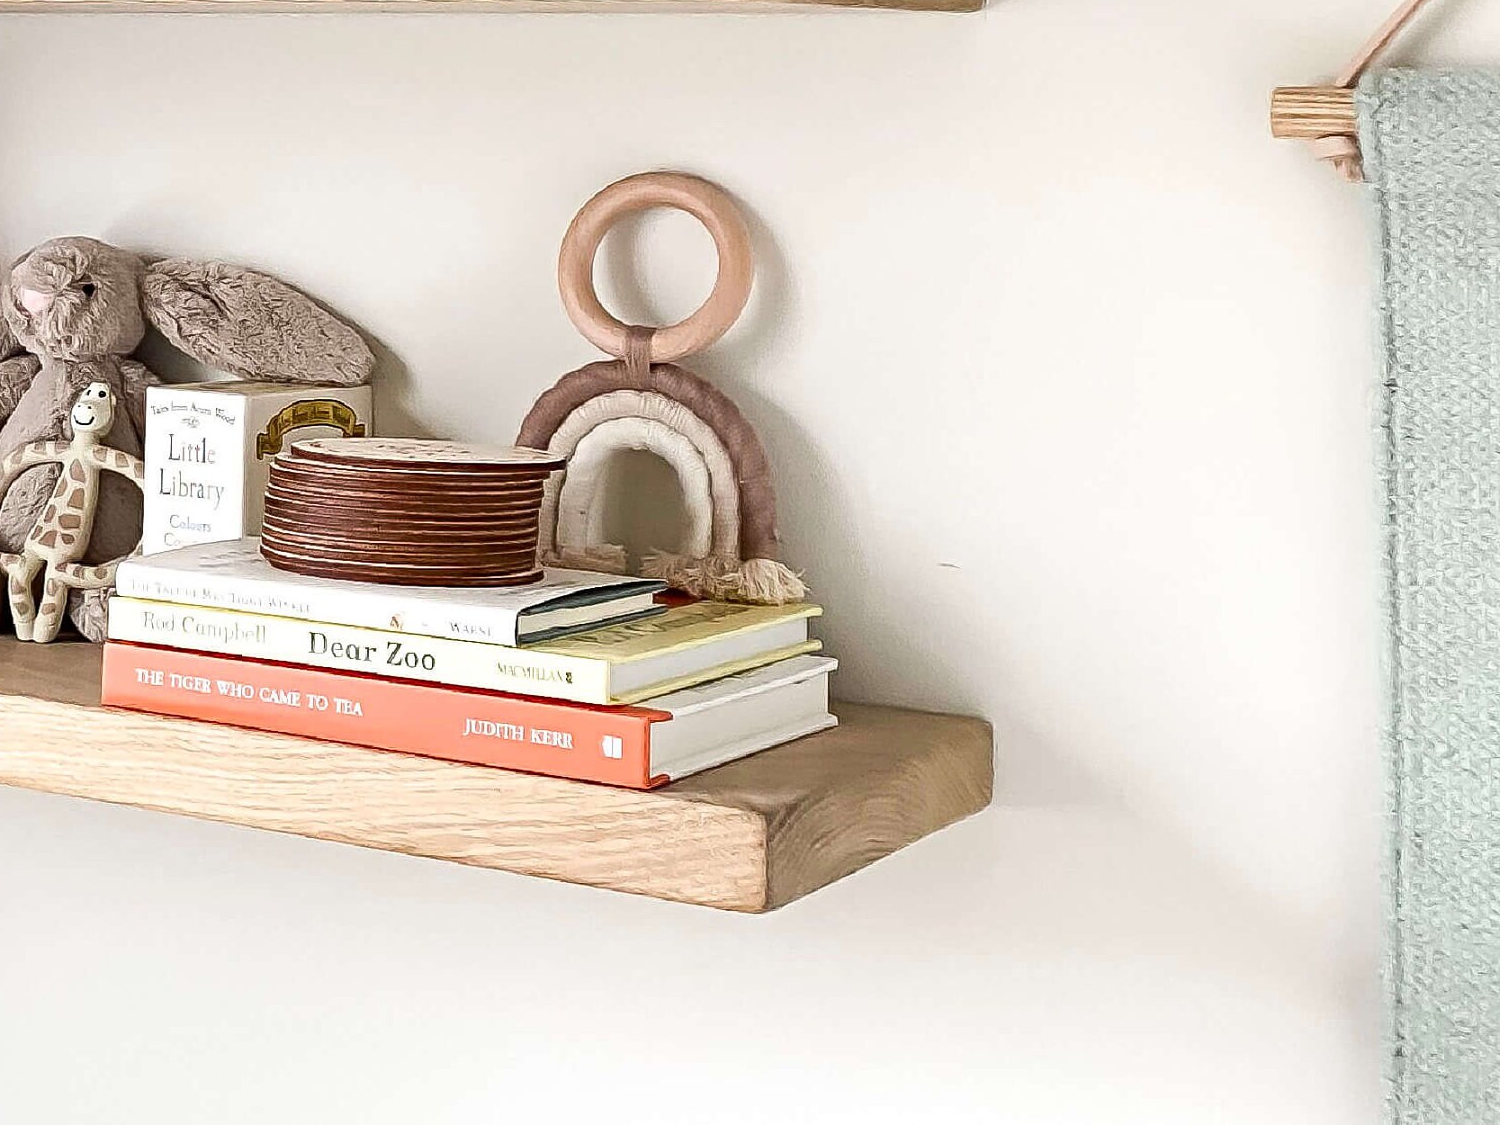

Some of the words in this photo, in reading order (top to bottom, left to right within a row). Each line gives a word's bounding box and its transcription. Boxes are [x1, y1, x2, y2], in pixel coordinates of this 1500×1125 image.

[167, 433, 217, 465] Little
[159, 468, 225, 511] Library
[142, 611, 175, 632] Rod
[182, 615, 267, 644] Campbell
[308, 631, 377, 663] Dear
[386, 641, 436, 671] Zoo
[497, 661, 563, 683] MACMILLAN
[135, 668, 164, 686] THE
[169, 673, 211, 694] TIGER
[216, 680, 254, 699] WHO
[259, 687, 301, 707] CAME
[306, 693, 329, 711] TO
[333, 697, 363, 717] TEA
[462, 717, 525, 742] JUDITH
[530, 727, 573, 750] KERR
